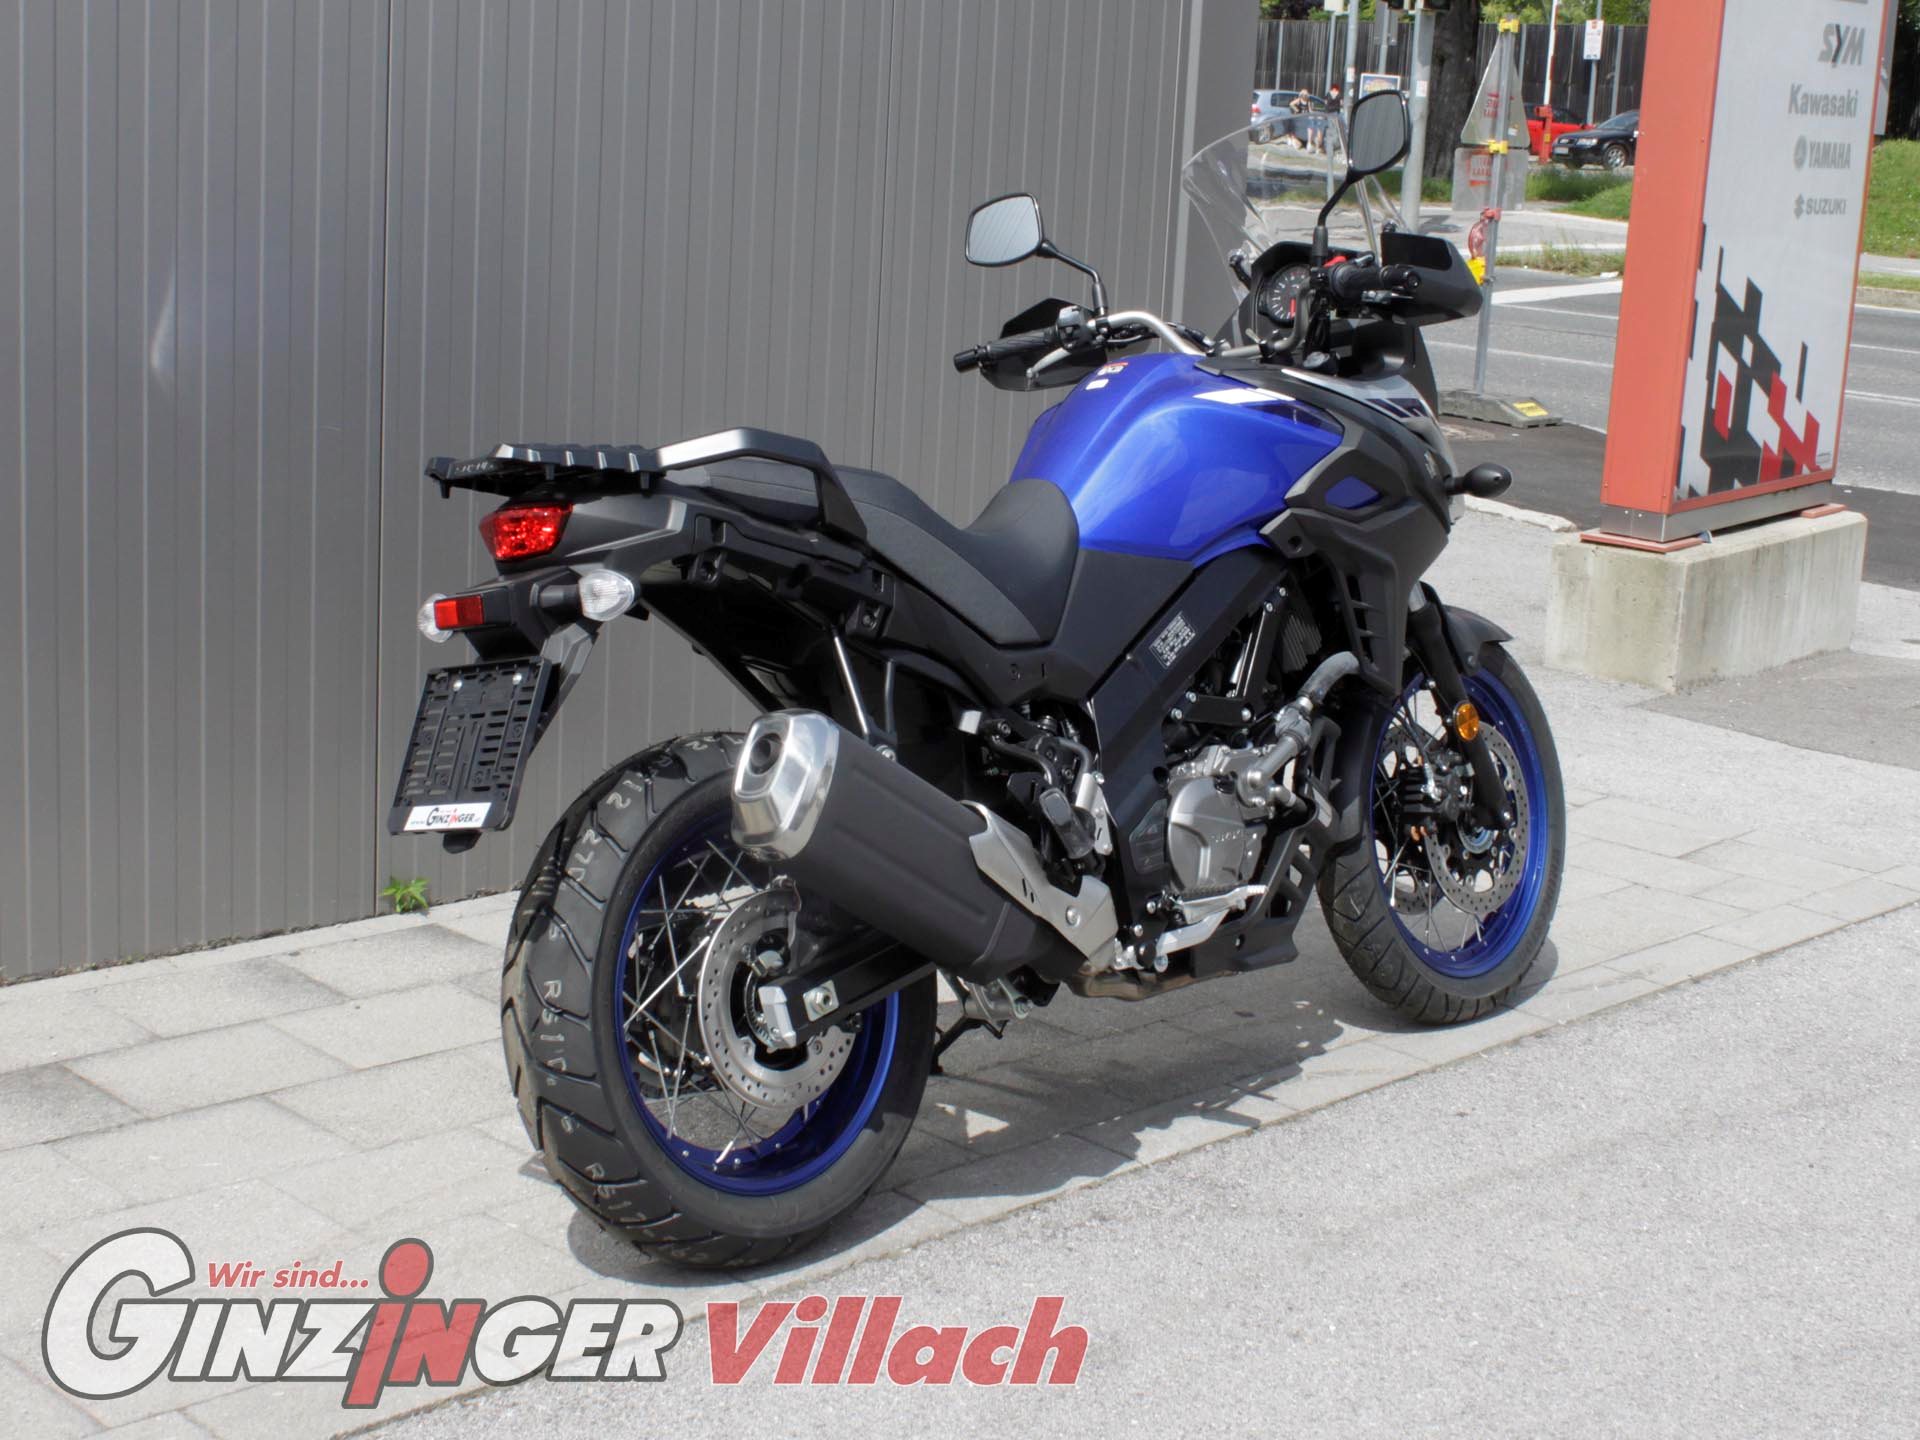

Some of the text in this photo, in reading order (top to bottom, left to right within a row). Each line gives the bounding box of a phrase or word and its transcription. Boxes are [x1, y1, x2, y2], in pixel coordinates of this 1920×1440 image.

[1818, 23, 1865, 68] SYM
[1788, 83, 1859, 118] Kawasaki
[1808, 141, 1851, 169] YAMAHA
[1805, 198, 1847, 215] SUZUKI
